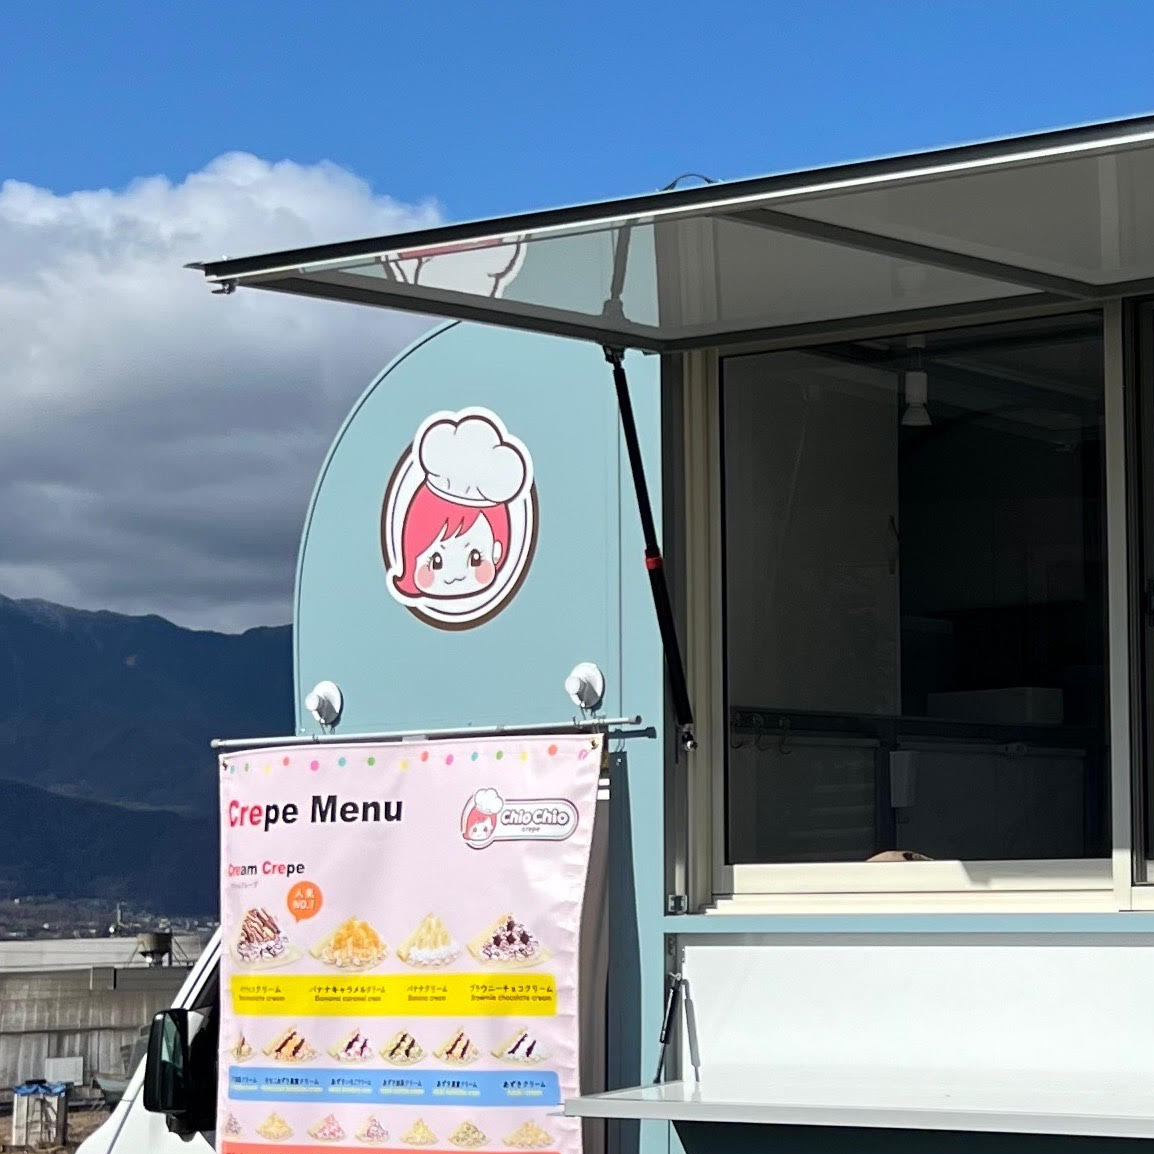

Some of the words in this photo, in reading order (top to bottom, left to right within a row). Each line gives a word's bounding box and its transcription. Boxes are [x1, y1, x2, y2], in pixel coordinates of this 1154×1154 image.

[229, 799, 298, 832] Crepe
[311, 795, 403, 823] Menu
[228, 863, 257, 878] Cream
[262, 861, 305, 878] Crepe
